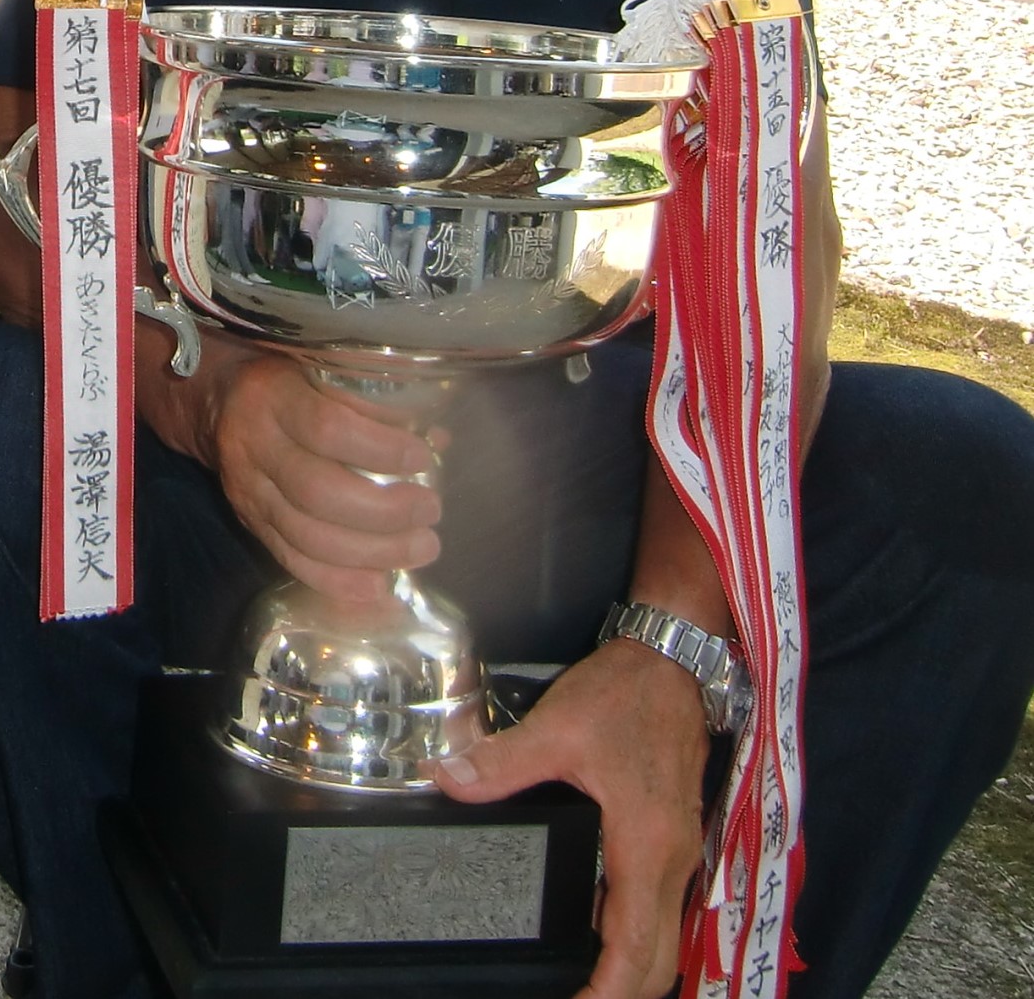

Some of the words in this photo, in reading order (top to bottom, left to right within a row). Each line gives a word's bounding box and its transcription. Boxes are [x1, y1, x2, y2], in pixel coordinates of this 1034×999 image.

[62, 158, 115, 261] 優勝
[759, 166, 795, 271] 優勝
[67, 431, 115, 585] 湯澤信夫
